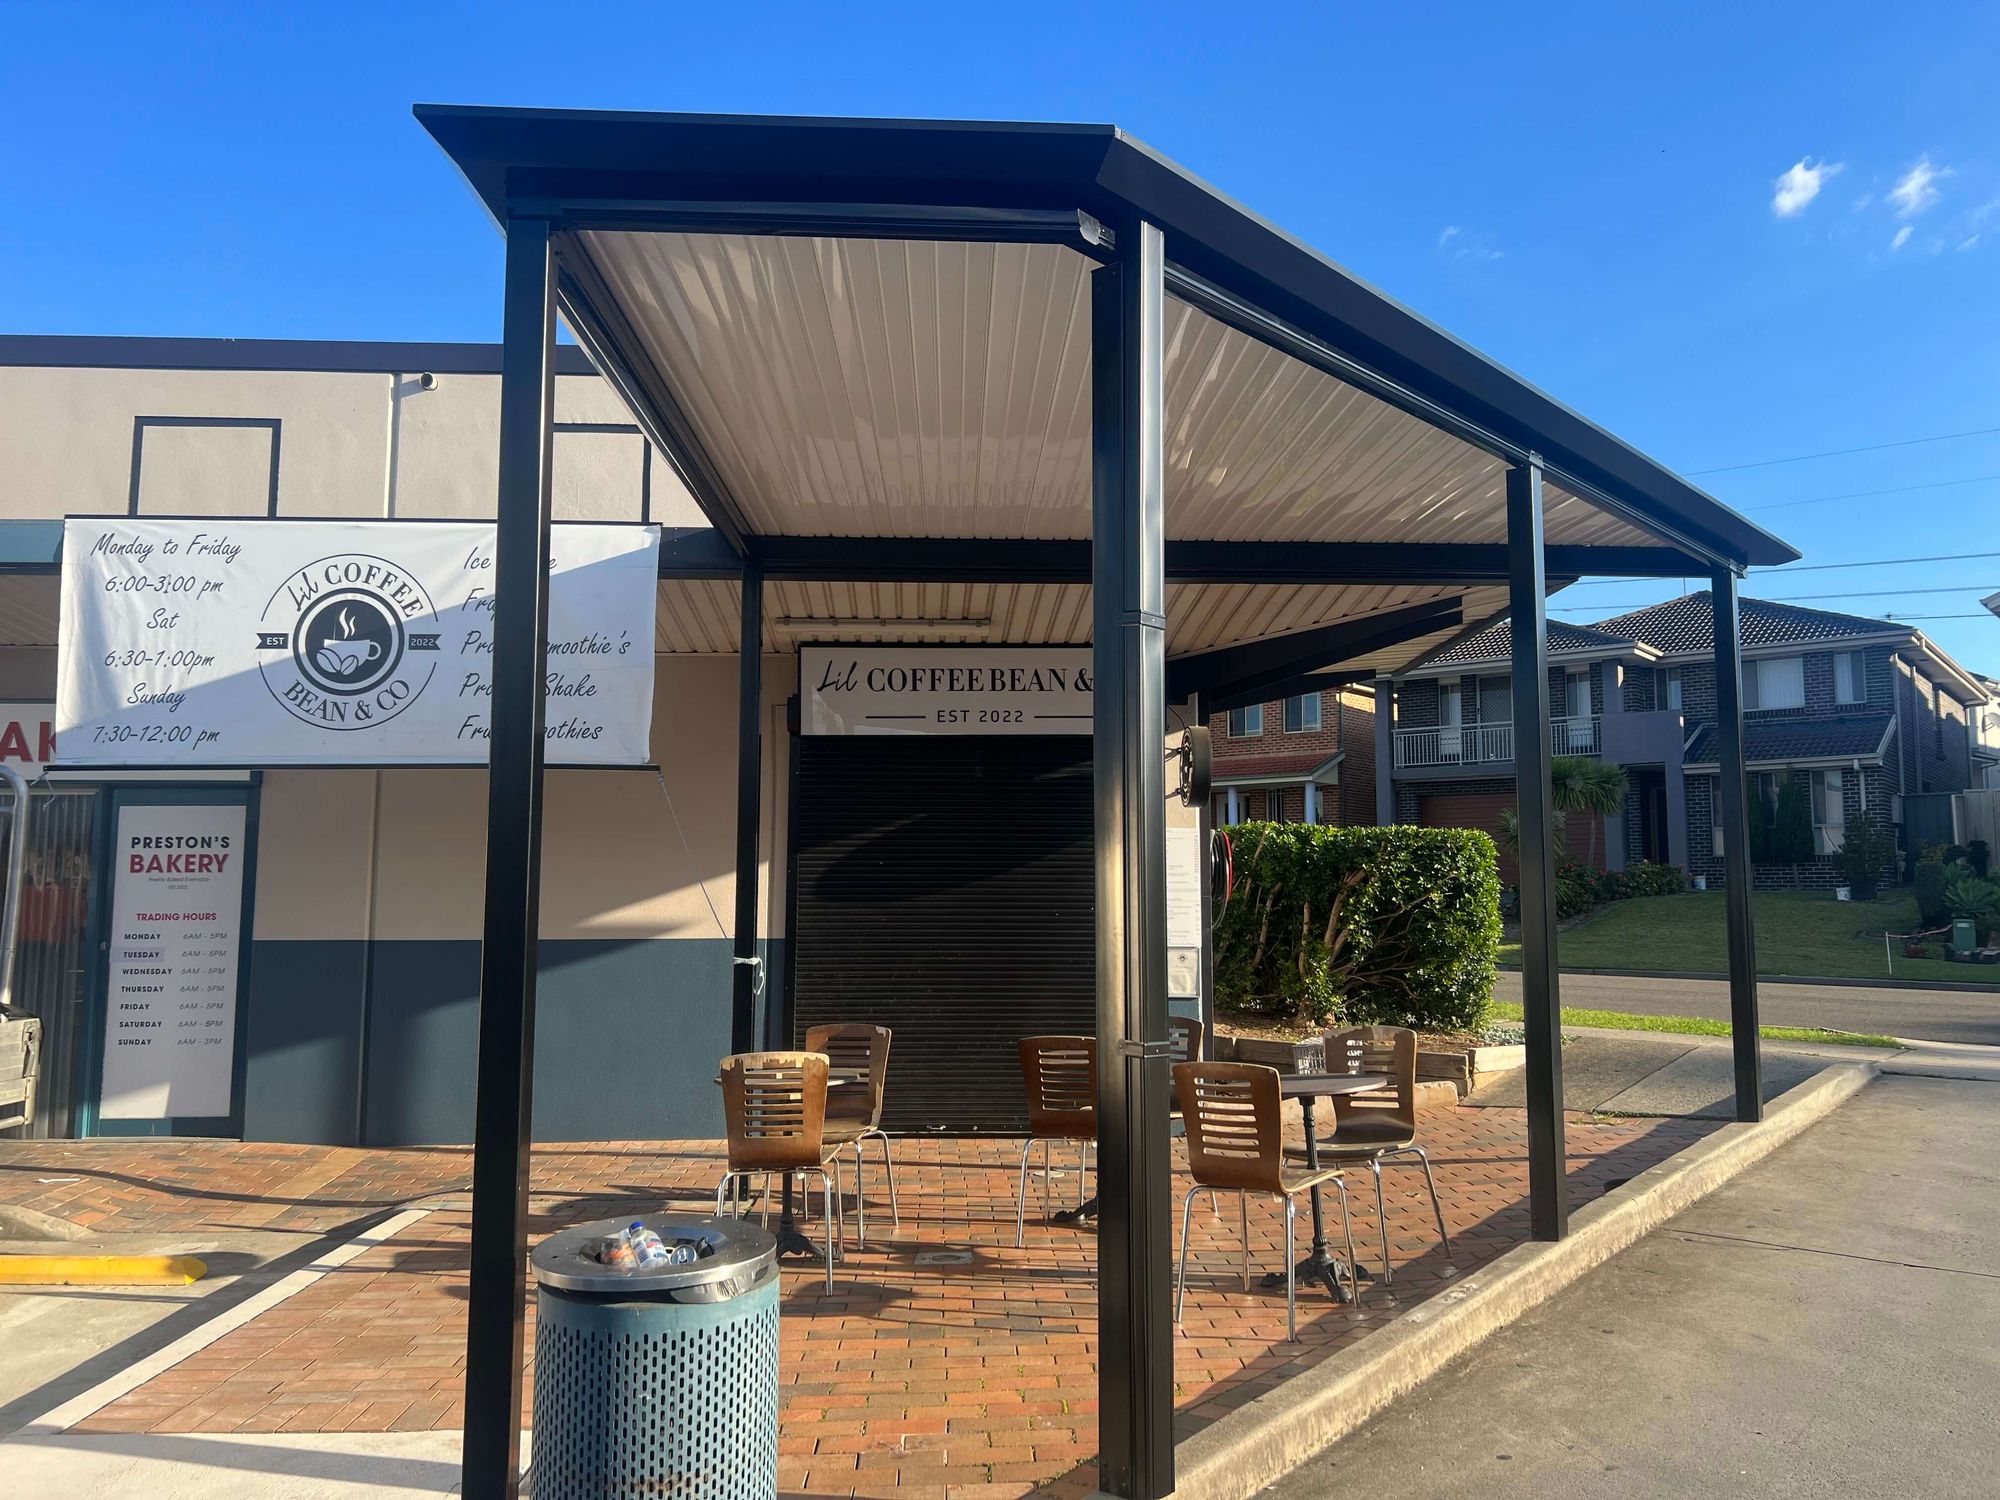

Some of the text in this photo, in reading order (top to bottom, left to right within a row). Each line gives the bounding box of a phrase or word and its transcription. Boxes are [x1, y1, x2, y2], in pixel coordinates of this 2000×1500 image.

[90, 532, 242, 564] Monday to Friday
[463, 546, 491, 570] Ice
[196, 578, 224, 600] pm
[287, 562, 424, 618] Lil COFFEE
[146, 607, 180, 629] Sat
[266, 637, 285, 646] EST
[410, 637, 435, 647] 2022
[545, 672, 598, 697] Shake
[817, 660, 858, 692] Lil
[1074, 667, 1093, 692] &
[127, 682, 187, 713] Sunday
[282, 679, 410, 722] BEAN & CO
[937, 709, 1024, 723] EST 2022
[93, 725, 221, 751] 7:30-12:00 pm
[131, 836, 230, 849] PRESTON'S
[129, 853, 230, 873] BAKERY
[136, 912, 217, 921] TRADING HOURS
[121, 985, 164, 993] THURSDAY
